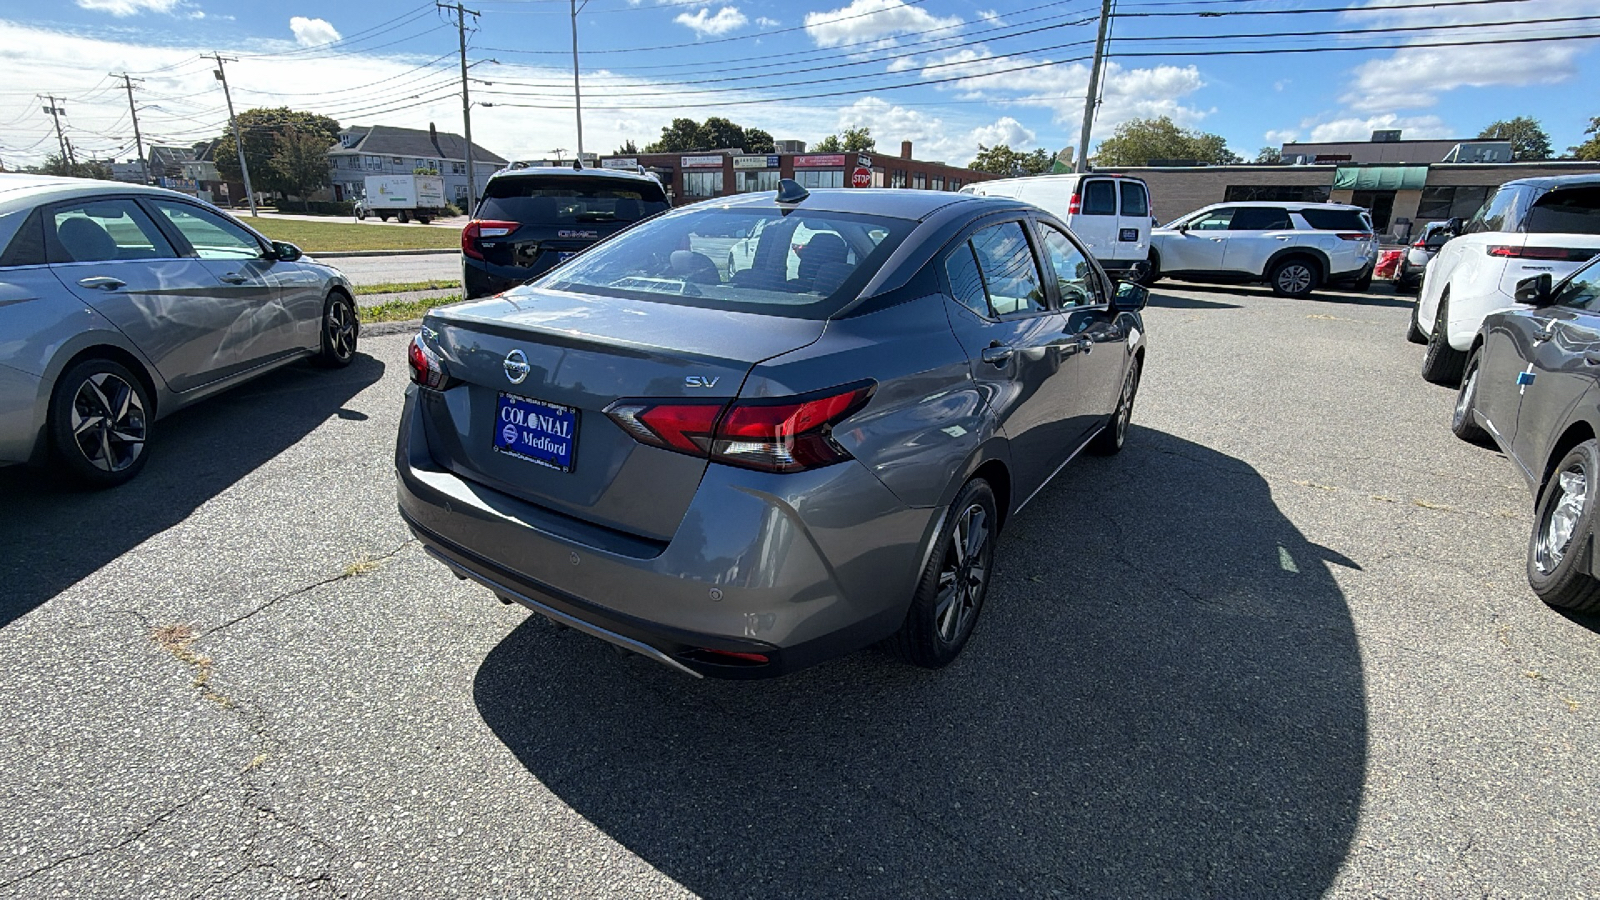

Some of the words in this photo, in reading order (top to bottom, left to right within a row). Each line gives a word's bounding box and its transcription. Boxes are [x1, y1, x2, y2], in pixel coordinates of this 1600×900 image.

[853, 174, 871, 184] STOP
[557, 230, 598, 238] GMC
[685, 376, 720, 388] SV
[501, 406, 572, 439] COLONIAL
[521, 431, 567, 456] Medford
